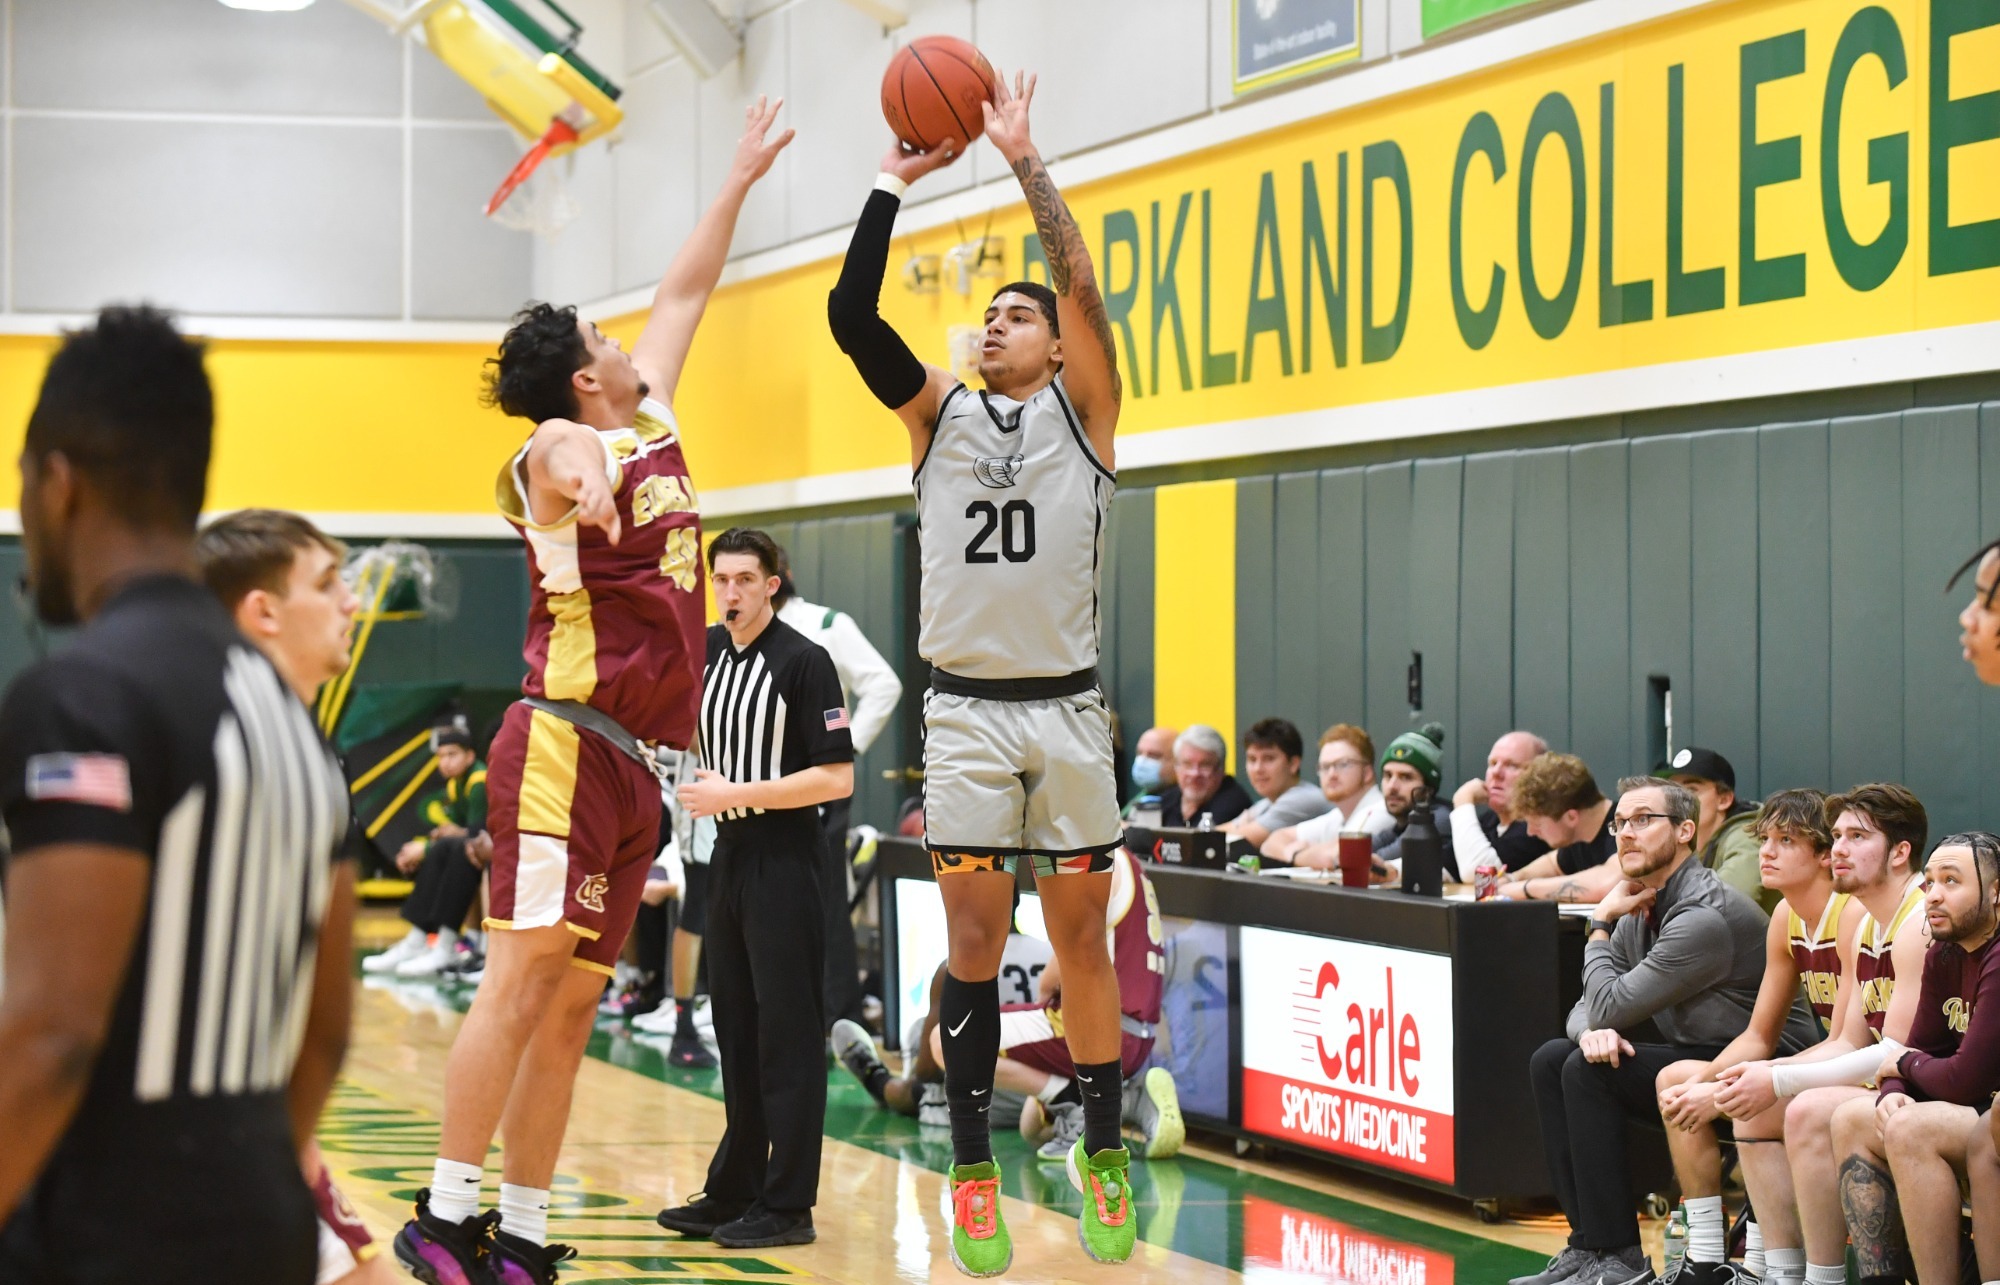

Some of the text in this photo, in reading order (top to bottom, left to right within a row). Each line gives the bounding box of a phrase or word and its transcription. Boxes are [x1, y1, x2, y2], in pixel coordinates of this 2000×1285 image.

[1024, 0, 2000, 399] RKLAND COLLEGE
[965, 499, 1036, 564] 20
[1314, 961, 1421, 1098] Carle
[1281, 1083, 1427, 1164] SPORTS MEDICINE
